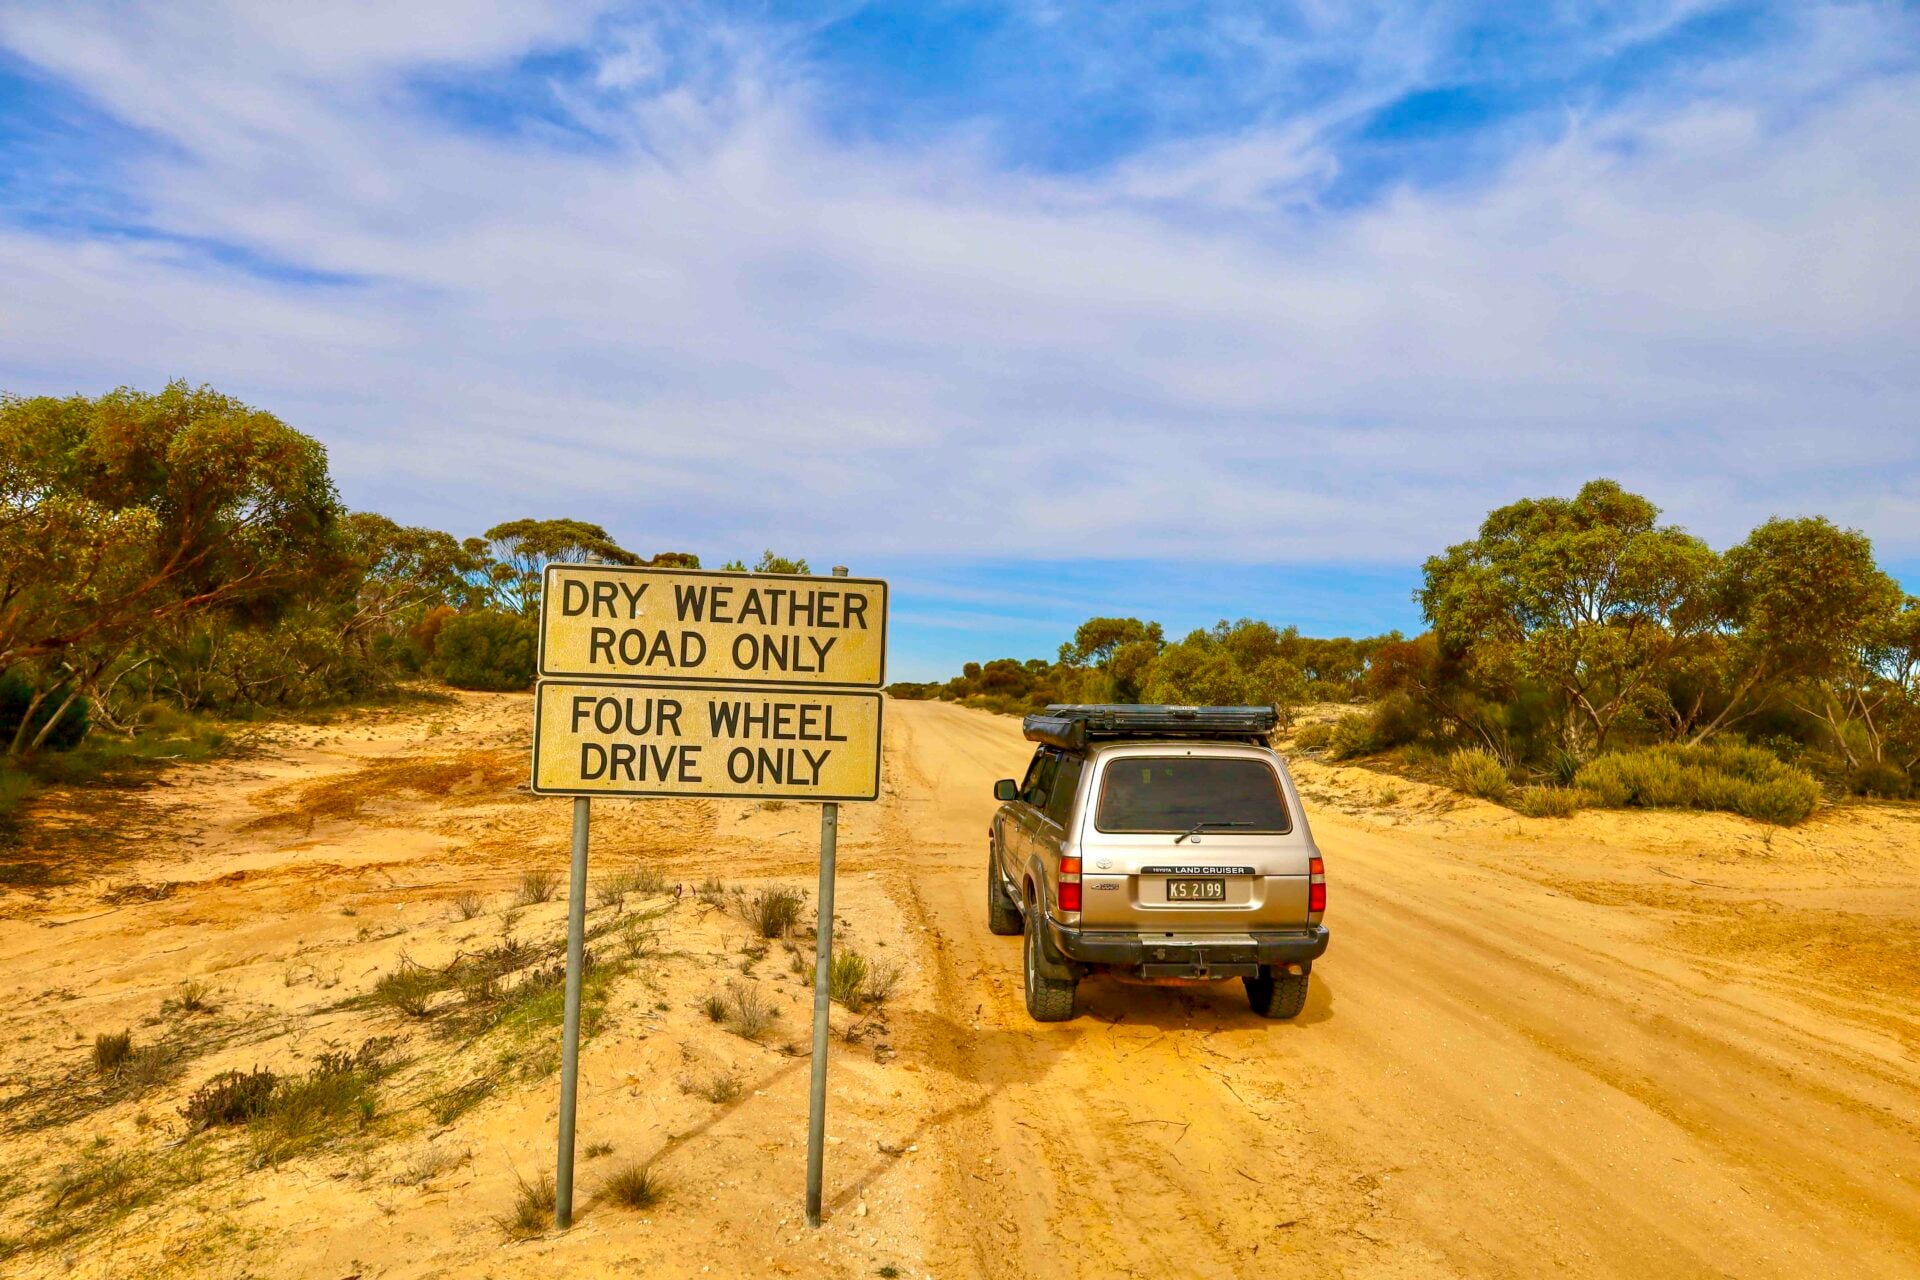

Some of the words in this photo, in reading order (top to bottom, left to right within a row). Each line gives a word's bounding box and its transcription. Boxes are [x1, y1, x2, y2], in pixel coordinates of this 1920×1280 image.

[562, 579, 650, 619] DRY
[674, 585, 868, 630] WEATHER
[589, 627, 707, 668] ROAD
[732, 633, 838, 673] ONLY
[571, 696, 682, 737] FOUR
[709, 701, 848, 742] WHEEL
[580, 742, 702, 783] DRIVE
[727, 746, 832, 786] ONLY
[1170, 883, 1187, 897] KS
[1192, 883, 1221, 897] 2199
